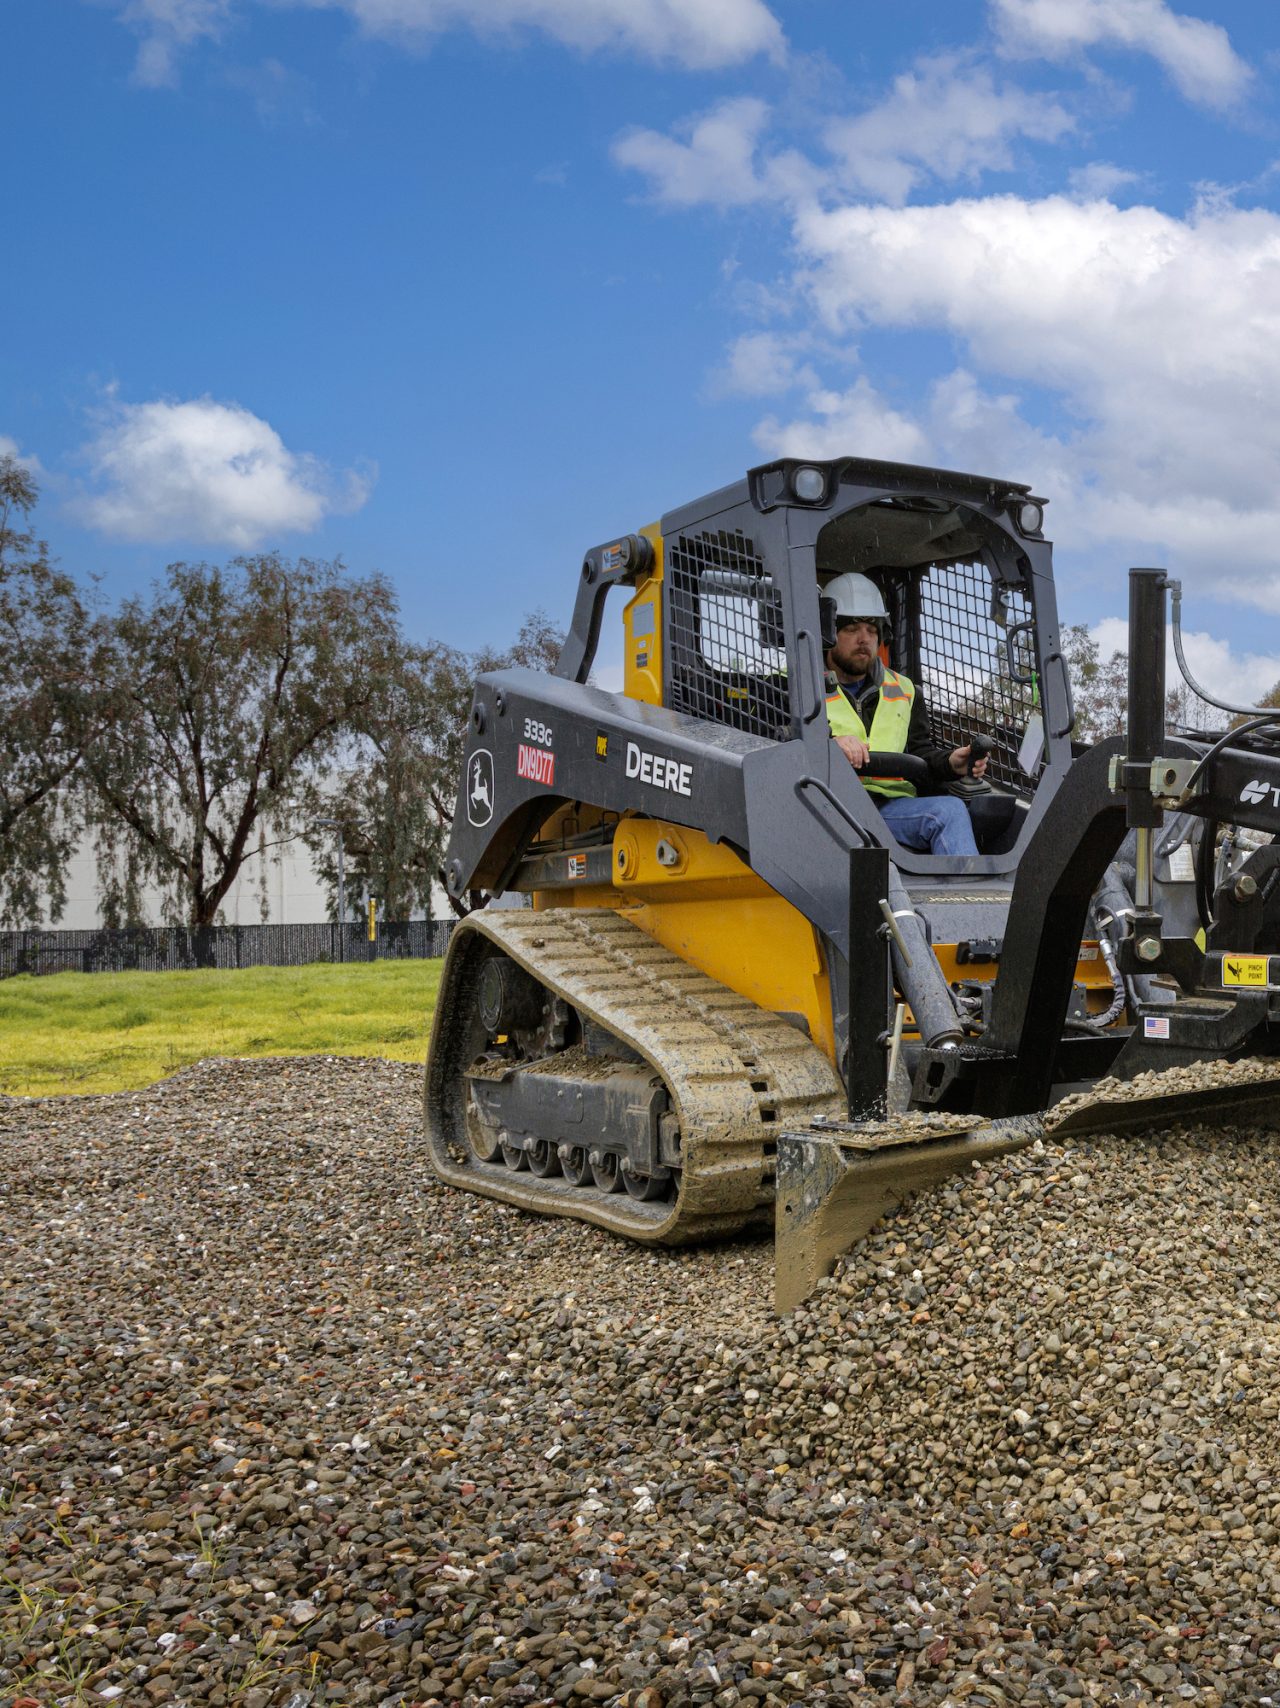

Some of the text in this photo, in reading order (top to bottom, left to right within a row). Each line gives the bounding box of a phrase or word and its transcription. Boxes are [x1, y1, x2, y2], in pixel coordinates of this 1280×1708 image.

[523, 717, 553, 747] 333G
[625, 741, 693, 797] DEERE
[1248, 964, 1263, 972] PINCH
[1248, 972, 1263, 980] POINT
